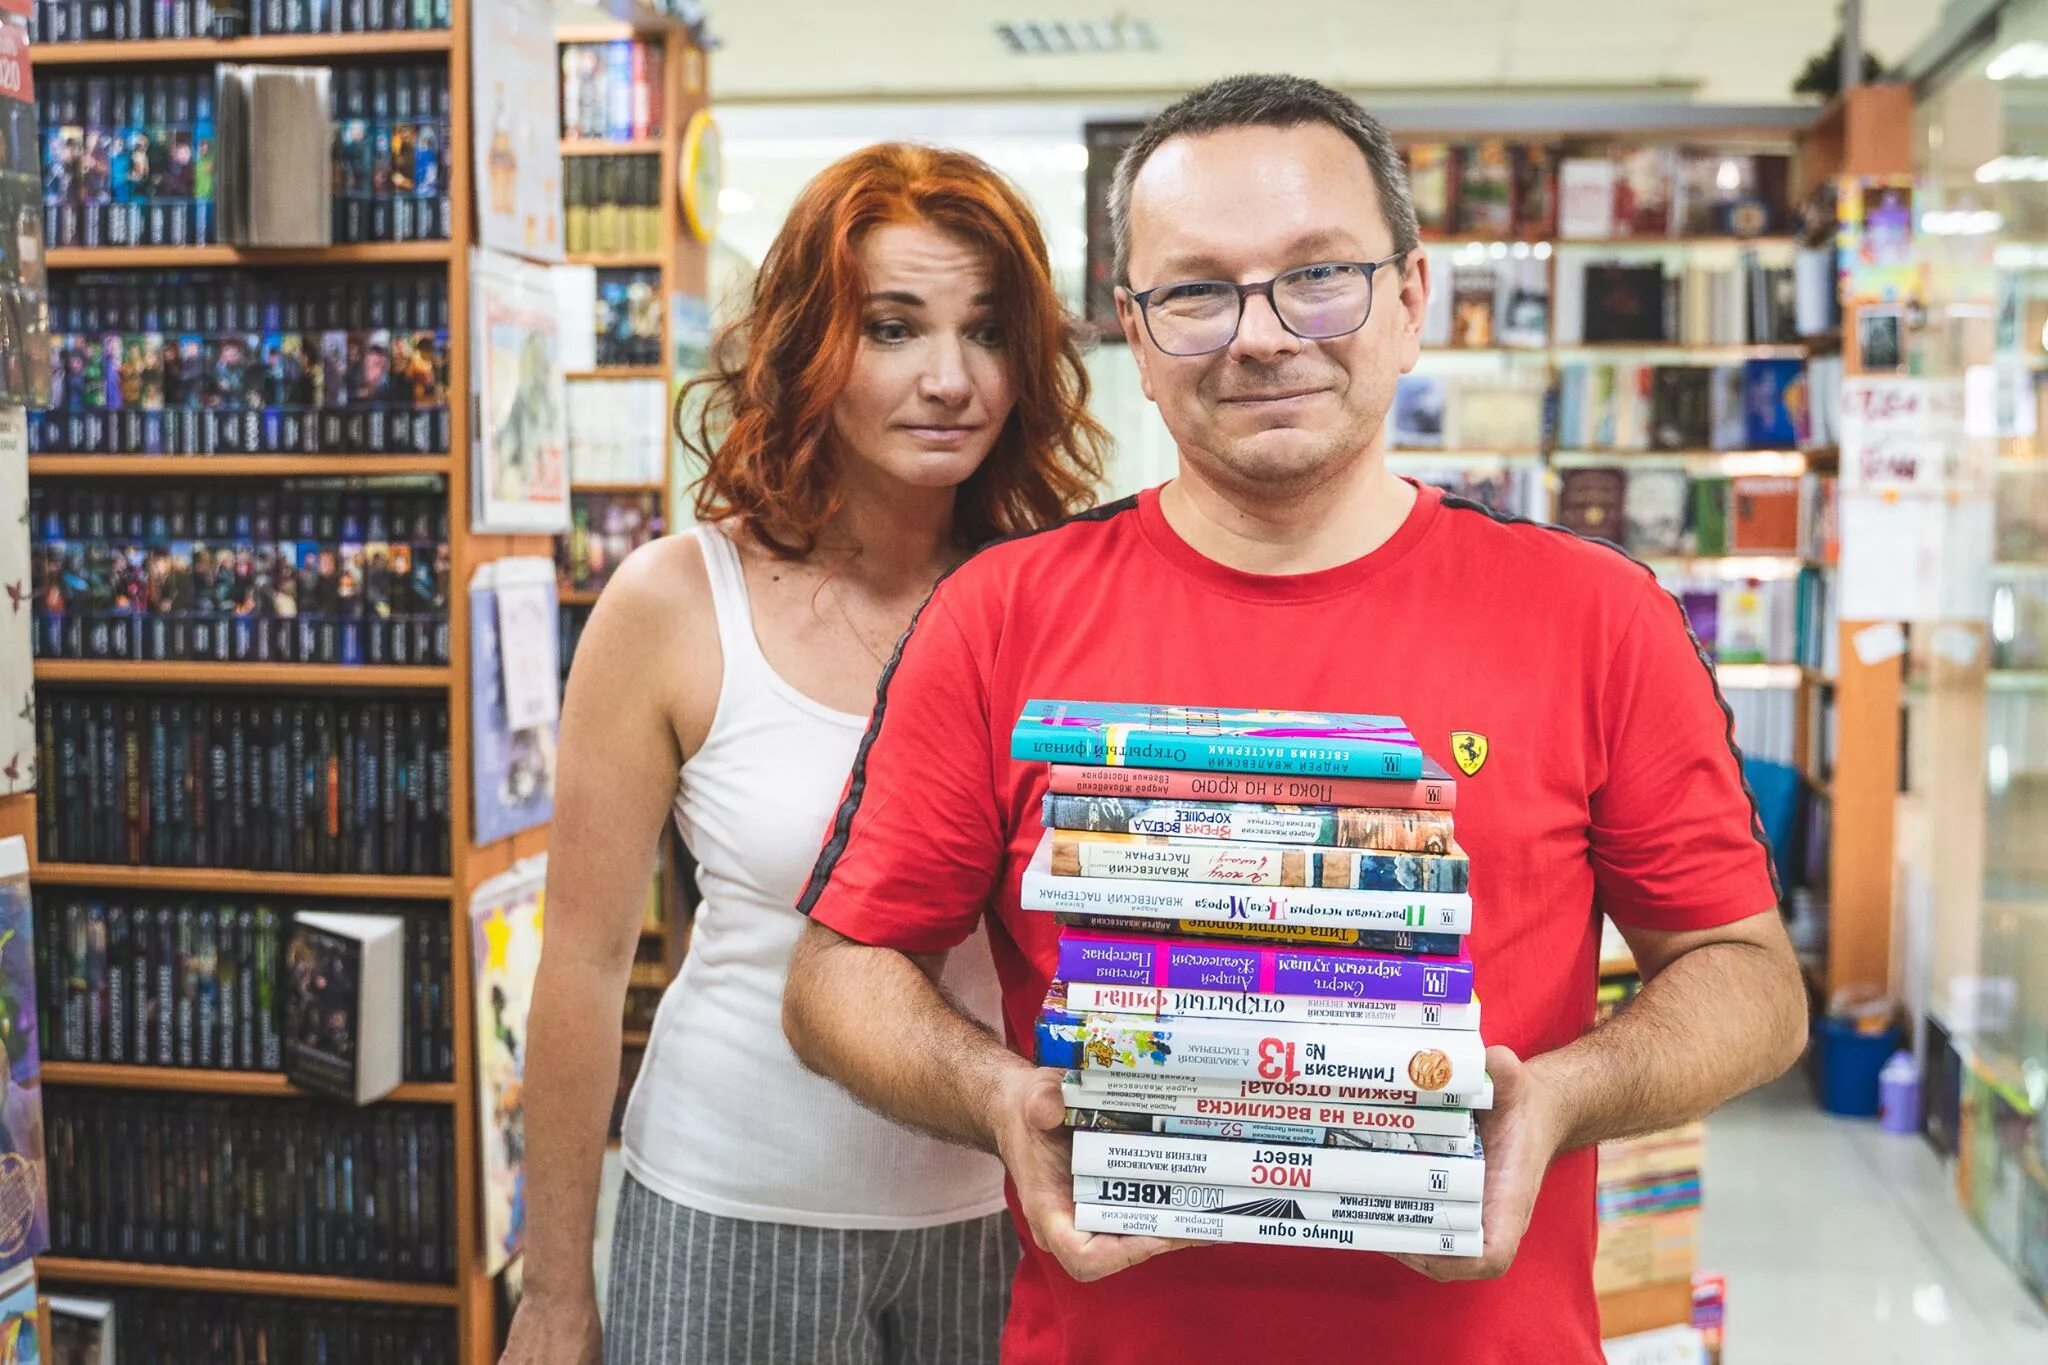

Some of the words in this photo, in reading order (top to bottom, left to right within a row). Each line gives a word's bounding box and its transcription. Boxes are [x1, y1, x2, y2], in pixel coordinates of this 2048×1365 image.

[0, 55, 20, 92] 20
[1033, 741, 1087, 758] финал
[1094, 744, 1186, 762] Открытый
[1208, 744, 1284, 758] ПАСТЕРНАК
[1291, 748, 1349, 761] ЕВГЕНИЯ
[1208, 758, 1292, 771] ЖВАЛЕВСКИЙ
[1299, 761, 1348, 773] АНДРЕЙ
[1081, 770, 1129, 781] Пастернак
[1132, 774, 1169, 784] Евгения
[1076, 782, 1133, 793] Жвалевский
[1135, 783, 1169, 794] Андрей
[1191, 777, 1238, 795] краю
[1245, 781, 1266, 797] на
[1273, 783, 1283, 799] я
[1289, 783, 1332, 803] Пока
[1174, 810, 1232, 824] ХОРОШЕЕ
[1246, 818, 1285, 827] ПАСТЕРНАК
[1133, 818, 1181, 834] ВСЕГДА
[1286, 820, 1316, 829] ЕВГЕНИЯ
[1185, 823, 1232, 840] ВРЕМЯ
[1241, 827, 1288, 838] ЖВАЛЕВСКИЙ
[1289, 828, 1315, 838] АНДРЕЙ
[1039, 889, 1101, 902] ПАСТЕРНАК
[1107, 893, 1183, 907] ЖВАЛЕВСКИЙ
[1195, 895, 1251, 919] Мороза
[1091, 917, 1141, 928] ЖВАЛЕВСКИЙ
[1141, 920, 1171, 930] АНДРЕЙ
[1310, 926, 1349, 942] Типа
[1082, 947, 1151, 967] Пастернак
[1171, 954, 1255, 974] Жвалевский
[1278, 958, 1330, 973] душам
[1334, 960, 1402, 979] мёртвым
[1096, 967, 1151, 985] Евгения
[1200, 970, 1254, 991] Андрей
[1313, 977, 1364, 996] Смерть
[1307, 999, 1344, 1008] ЕВГЕНИЯ
[1347, 1001, 1397, 1011] ПАСТЕРНАК
[1307, 1009, 1364, 1019] ЖВАЛЕВСКИЙ
[1364, 1011, 1396, 1020] АНДРЕЙ
[1188, 1044, 1240, 1055] ПАСТЕРНАК
[1241, 1047, 1249, 1056] Е.
[1177, 1054, 1239, 1066] ЖВАЛЕВСКИЙ
[1241, 1058, 1249, 1066] А.
[1257, 1037, 1301, 1083] 13
[1304, 1063, 1395, 1083] Гимназия
[1107, 1083, 1163, 1092] Жвалевский
[1165, 1085, 1198, 1093] Андрей
[1240, 1080, 1331, 1097] отсюда!
[1101, 1100, 1148, 1109] Жвалевский
[1147, 1094, 1177, 1102] Евгения
[1150, 1104, 1177, 1112] Андрей
[1196, 1099, 1312, 1122] василиска
[1319, 1109, 1345, 1126] на
[1353, 1111, 1415, 1130] охота
[1252, 1124, 1287, 1133] Пастернак
[1287, 1126, 1314, 1134] Евгения
[1108, 1146, 1163, 1160] ПАСТЕРНАК
[1165, 1150, 1207, 1162] ЕВГЕНИЯ
[1106, 1159, 1169, 1173] ЖВАЛЕВСКИЙ
[1170, 1163, 1207, 1175] АНДРЕЙ
[1251, 1165, 1312, 1188] МОС
[1098, 1180, 1224, 1209] МОСКВЕСТ
[1339, 1195, 1392, 1210] ПАСТЕРНАК
[1394, 1199, 1435, 1212] ЕВГЕНИЯ
[1101, 1210, 1159, 1223] Жвалевский
[1173, 1215, 1224, 1227] Пастернак
[1331, 1208, 1395, 1224] ЖВАЛЕВСКИЙ
[1397, 1213, 1434, 1226] АНДРЕЙ
[1122, 1222, 1158, 1233] Андрей
[1185, 1226, 1223, 1238] Евгения
[1258, 1221, 1297, 1237] один
[1302, 1223, 1354, 1244] Минус
